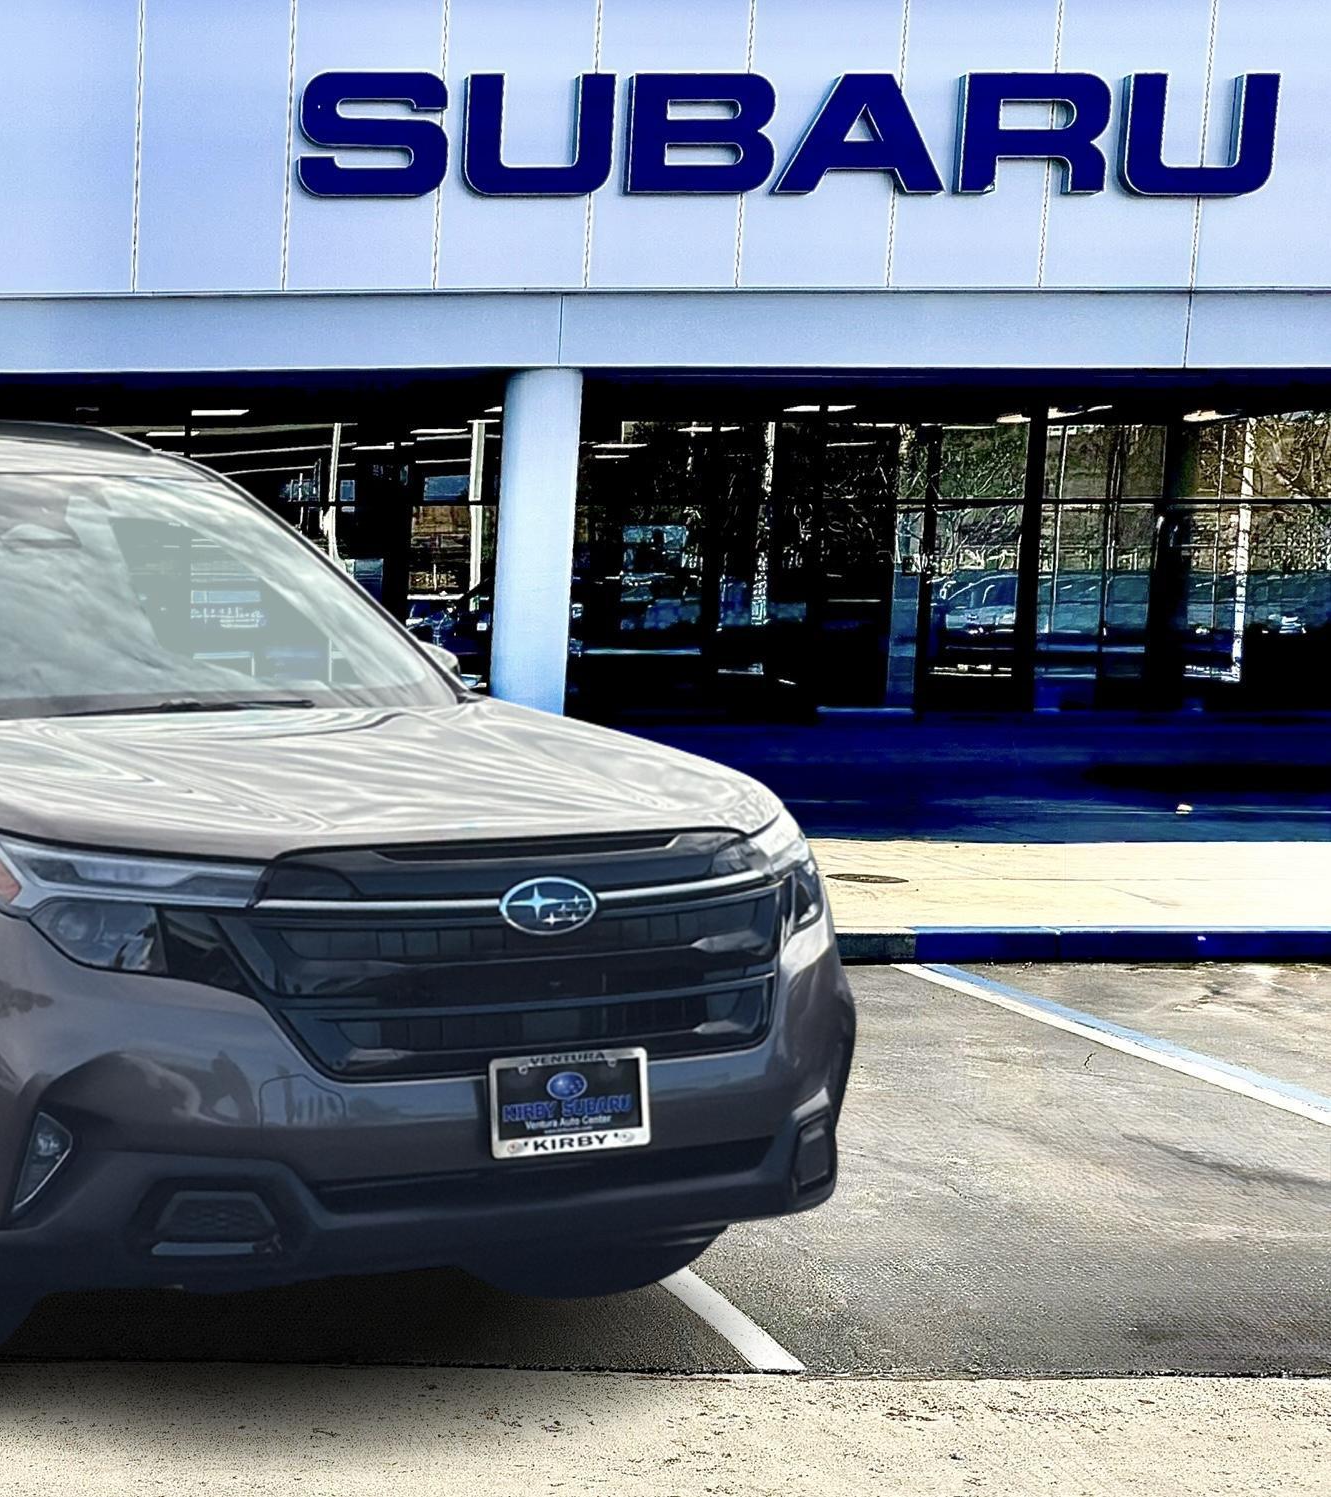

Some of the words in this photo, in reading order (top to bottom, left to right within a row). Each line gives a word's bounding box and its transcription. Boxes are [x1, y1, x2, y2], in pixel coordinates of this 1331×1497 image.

[297, 71, 1282, 197] SUBARU
[530, 1051, 606, 1067] VENTURA
[502, 1100, 557, 1122] KIRBY
[562, 1094, 632, 1117] SUBARU
[525, 1120, 557, 1130] Ventura
[559, 1117, 580, 1127] Auto
[582, 1114, 612, 1125] Center
[533, 1133, 608, 1151] KIRBY
